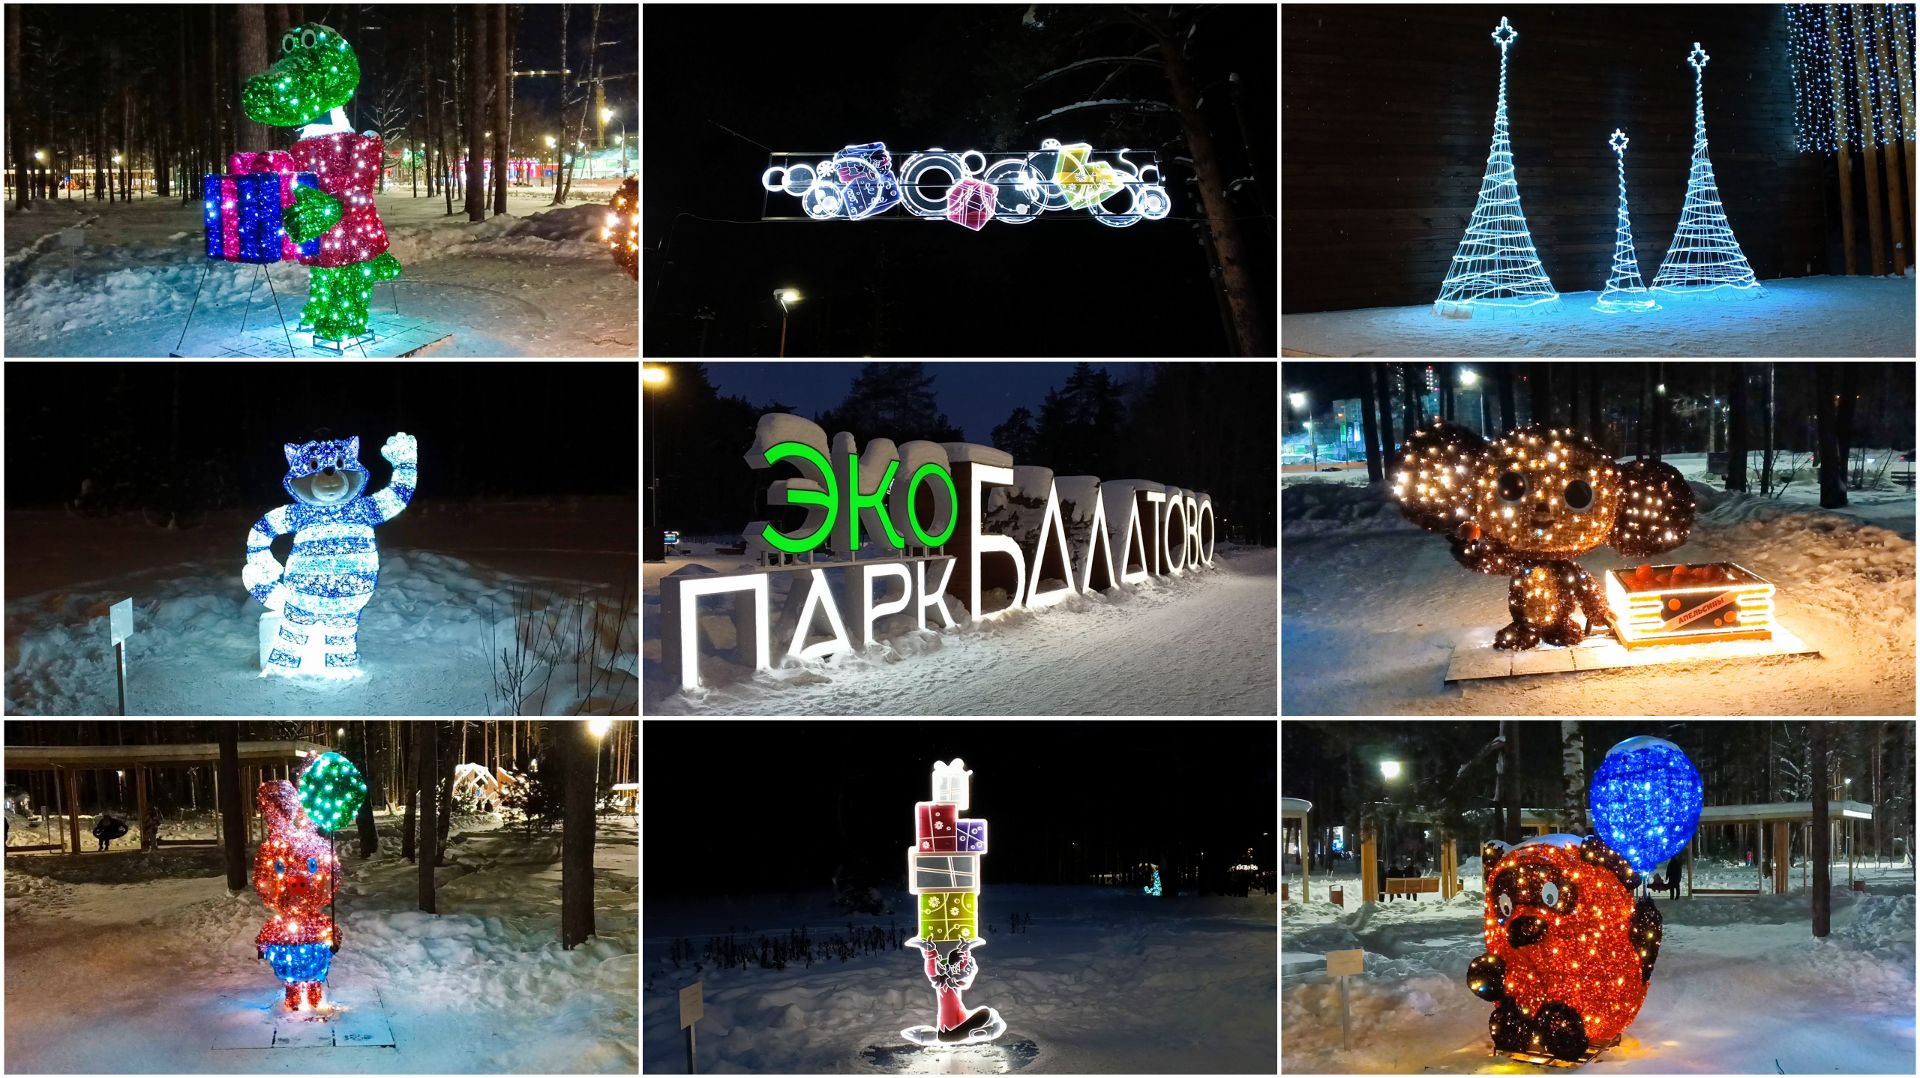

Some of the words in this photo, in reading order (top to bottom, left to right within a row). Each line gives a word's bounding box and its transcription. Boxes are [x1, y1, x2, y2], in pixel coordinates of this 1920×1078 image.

[762, 441, 958, 553] ЭКО
[680, 558, 960, 689] ПАРК
[971, 462, 1215, 621] БАЛАТОВО
[1678, 597, 1725, 624] АПЕЛЬСИНЫ
